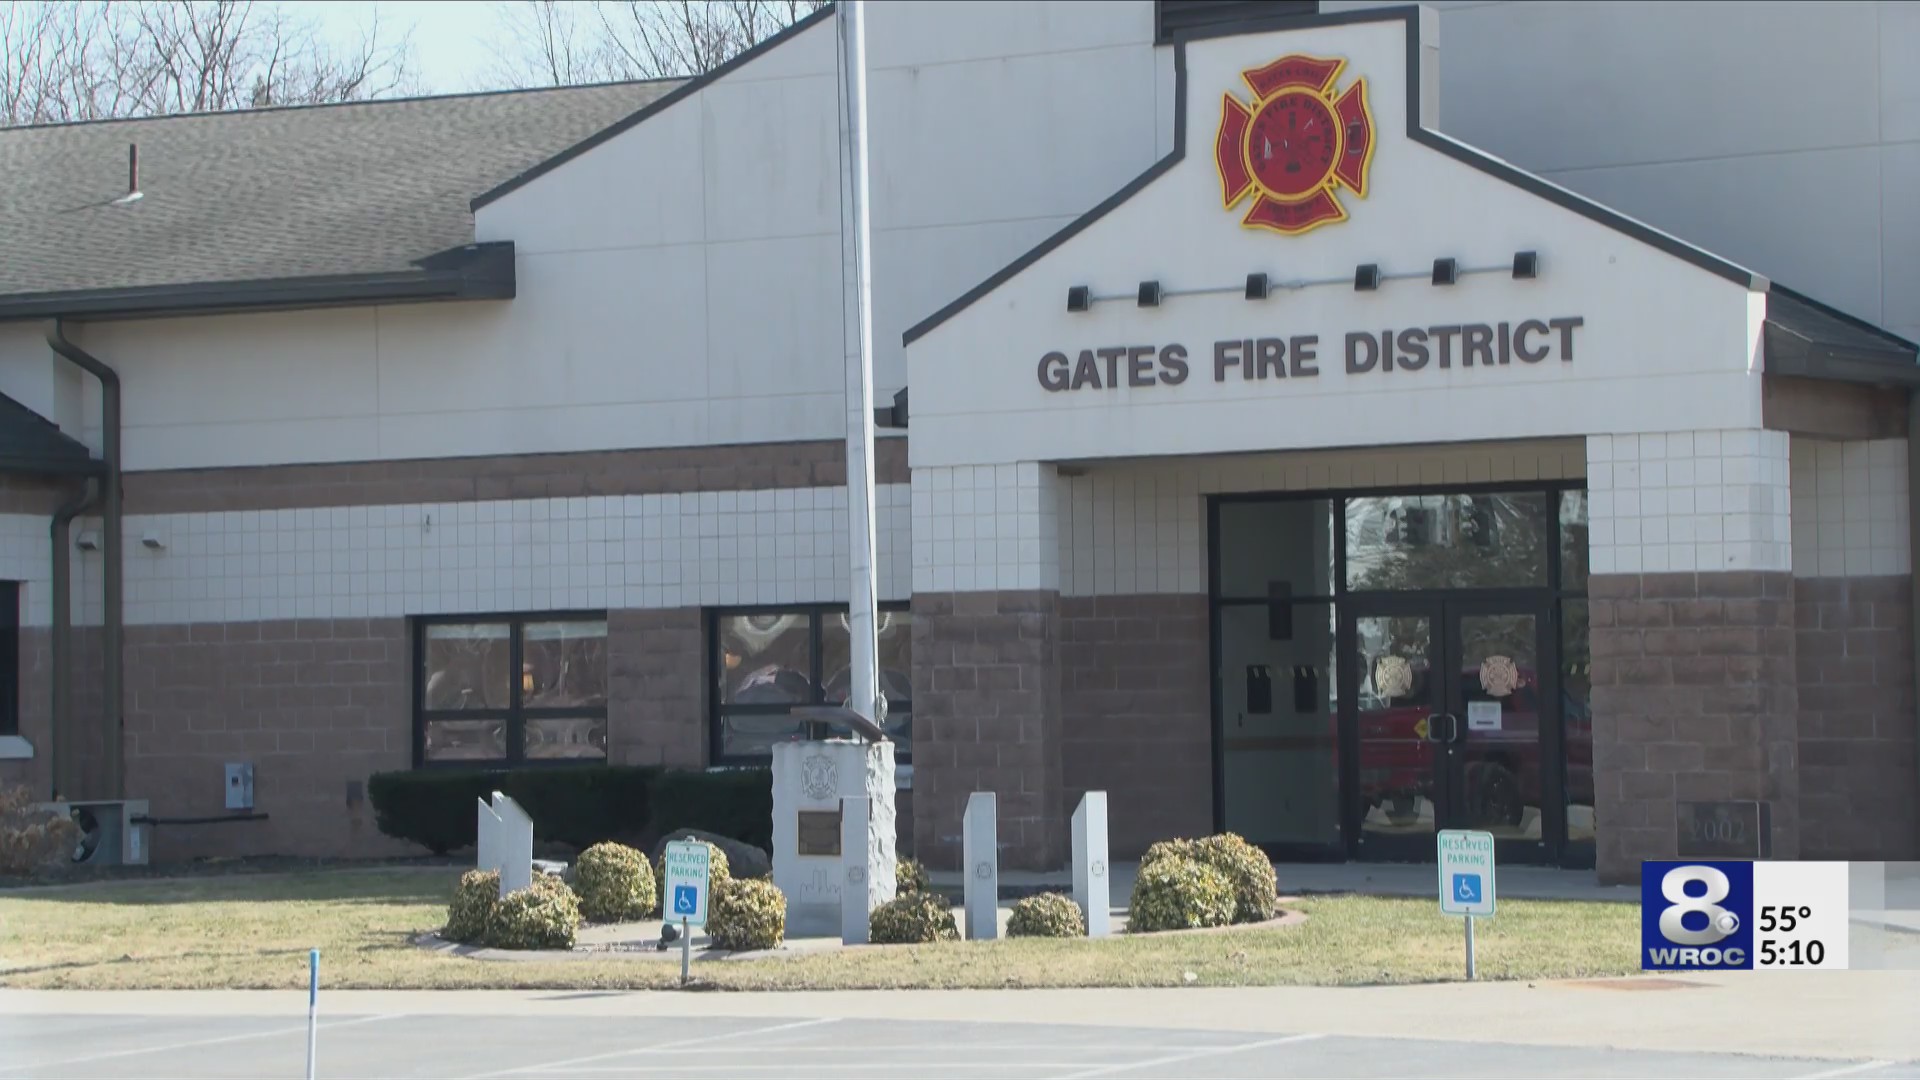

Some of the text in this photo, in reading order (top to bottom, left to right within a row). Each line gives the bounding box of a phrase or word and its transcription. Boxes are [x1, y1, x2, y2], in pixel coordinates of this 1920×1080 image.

[1037, 316, 1584, 392] GATES FIRE DISTRICT
[1442, 839, 1490, 851] RESERVED
[669, 852, 706, 864] RESERVED
[1447, 853, 1485, 866] PARKING
[671, 866, 703, 878] PARKING
